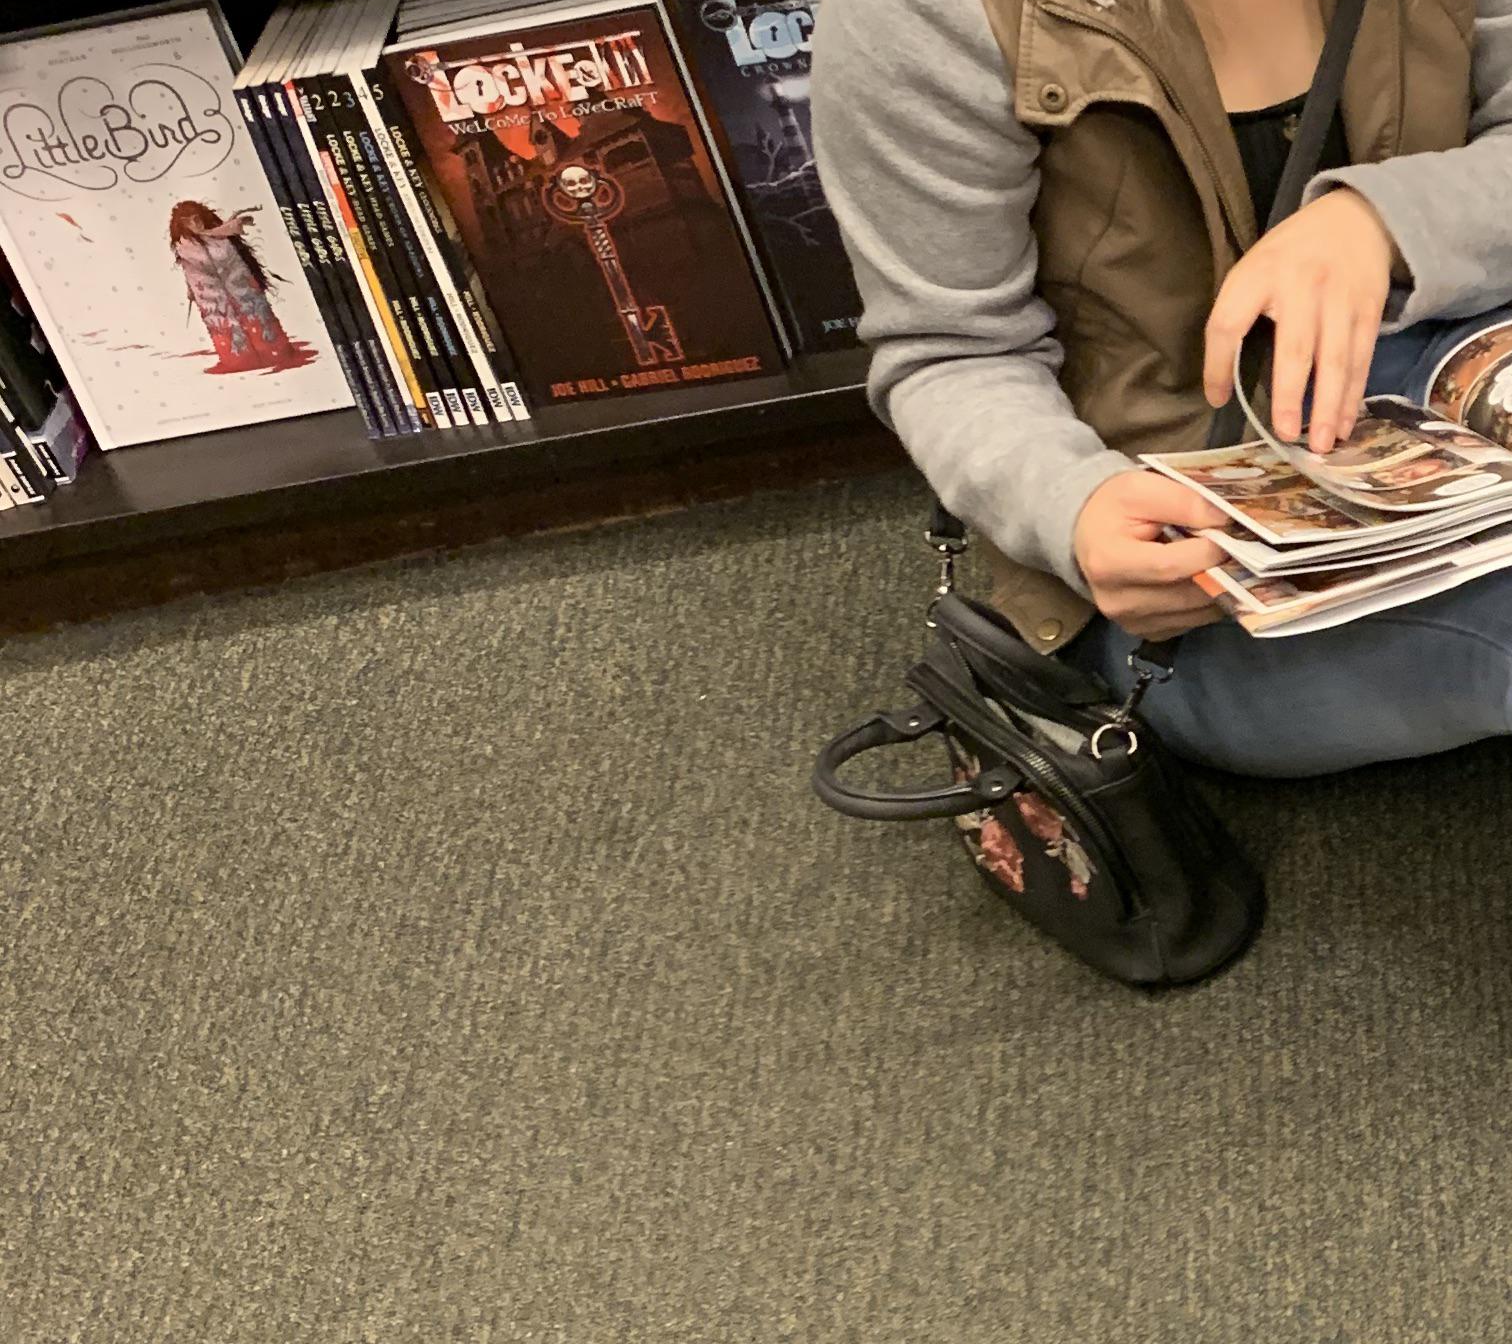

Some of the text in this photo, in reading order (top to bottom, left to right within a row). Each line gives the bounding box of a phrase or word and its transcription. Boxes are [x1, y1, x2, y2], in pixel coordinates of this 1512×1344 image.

[428, 30, 657, 123] LOCKE & KEY
[309, 93, 325, 111] 2
[327, 90, 342, 109] 2
[344, 91, 356, 110] 3
[358, 86, 370, 103] 4
[372, 83, 385, 102] 5
[3, 76, 222, 186] Little Bird
[373, 126, 393, 159] LOCKE
[323, 131, 346, 168] LOCKE
[341, 128, 362, 163] LOCKE
[389, 123, 411, 160] LOCKE
[407, 166, 423, 189] KEY
[338, 165, 349, 178] &
[354, 161, 365, 172] &
[358, 129, 379, 163] LOCKE
[375, 171, 391, 194] KEY
[343, 179, 358, 197] KEY
[358, 170, 374, 194] KEY
[278, 202, 302, 238] LITTLE
[296, 198, 319, 235] LITTLE
[311, 196, 335, 233] LITTLE
[551, 356, 762, 398] JOE HILL GABRIEL RODRIGUEZ
[427, 394, 444, 418] IDW
[445, 391, 462, 415] IDW
[465, 390, 482, 414] IDW
[486, 386, 503, 410] IDW
[505, 385, 520, 408] IDW
